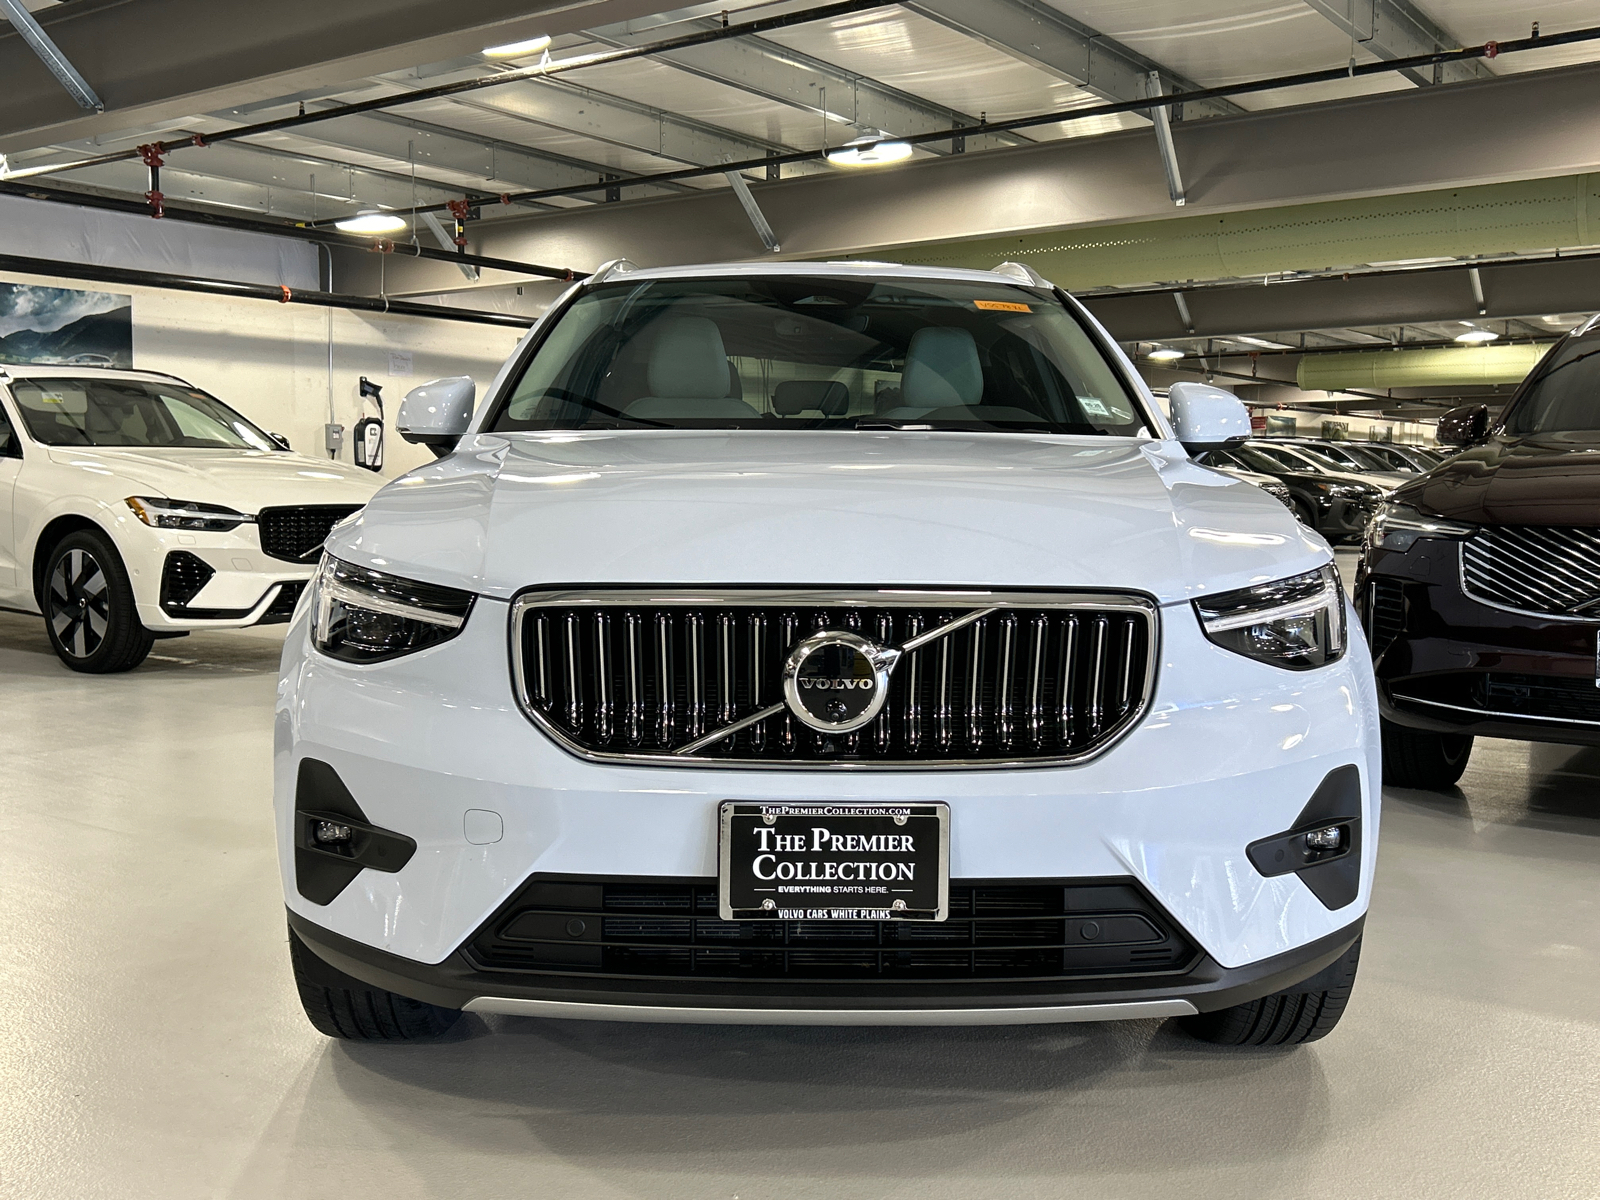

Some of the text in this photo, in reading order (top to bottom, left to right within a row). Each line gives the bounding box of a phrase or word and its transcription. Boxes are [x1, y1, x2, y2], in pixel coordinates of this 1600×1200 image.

[798, 678, 873, 690] VOLVO
[753, 827, 915, 852] THE PREMIER
[752, 854, 915, 880] COLLECTION
[833, 886, 864, 894] STARTS
[865, 886, 890, 894] HERE.
[778, 909, 891, 919] VOLVO CARS WHITE PLAINS
